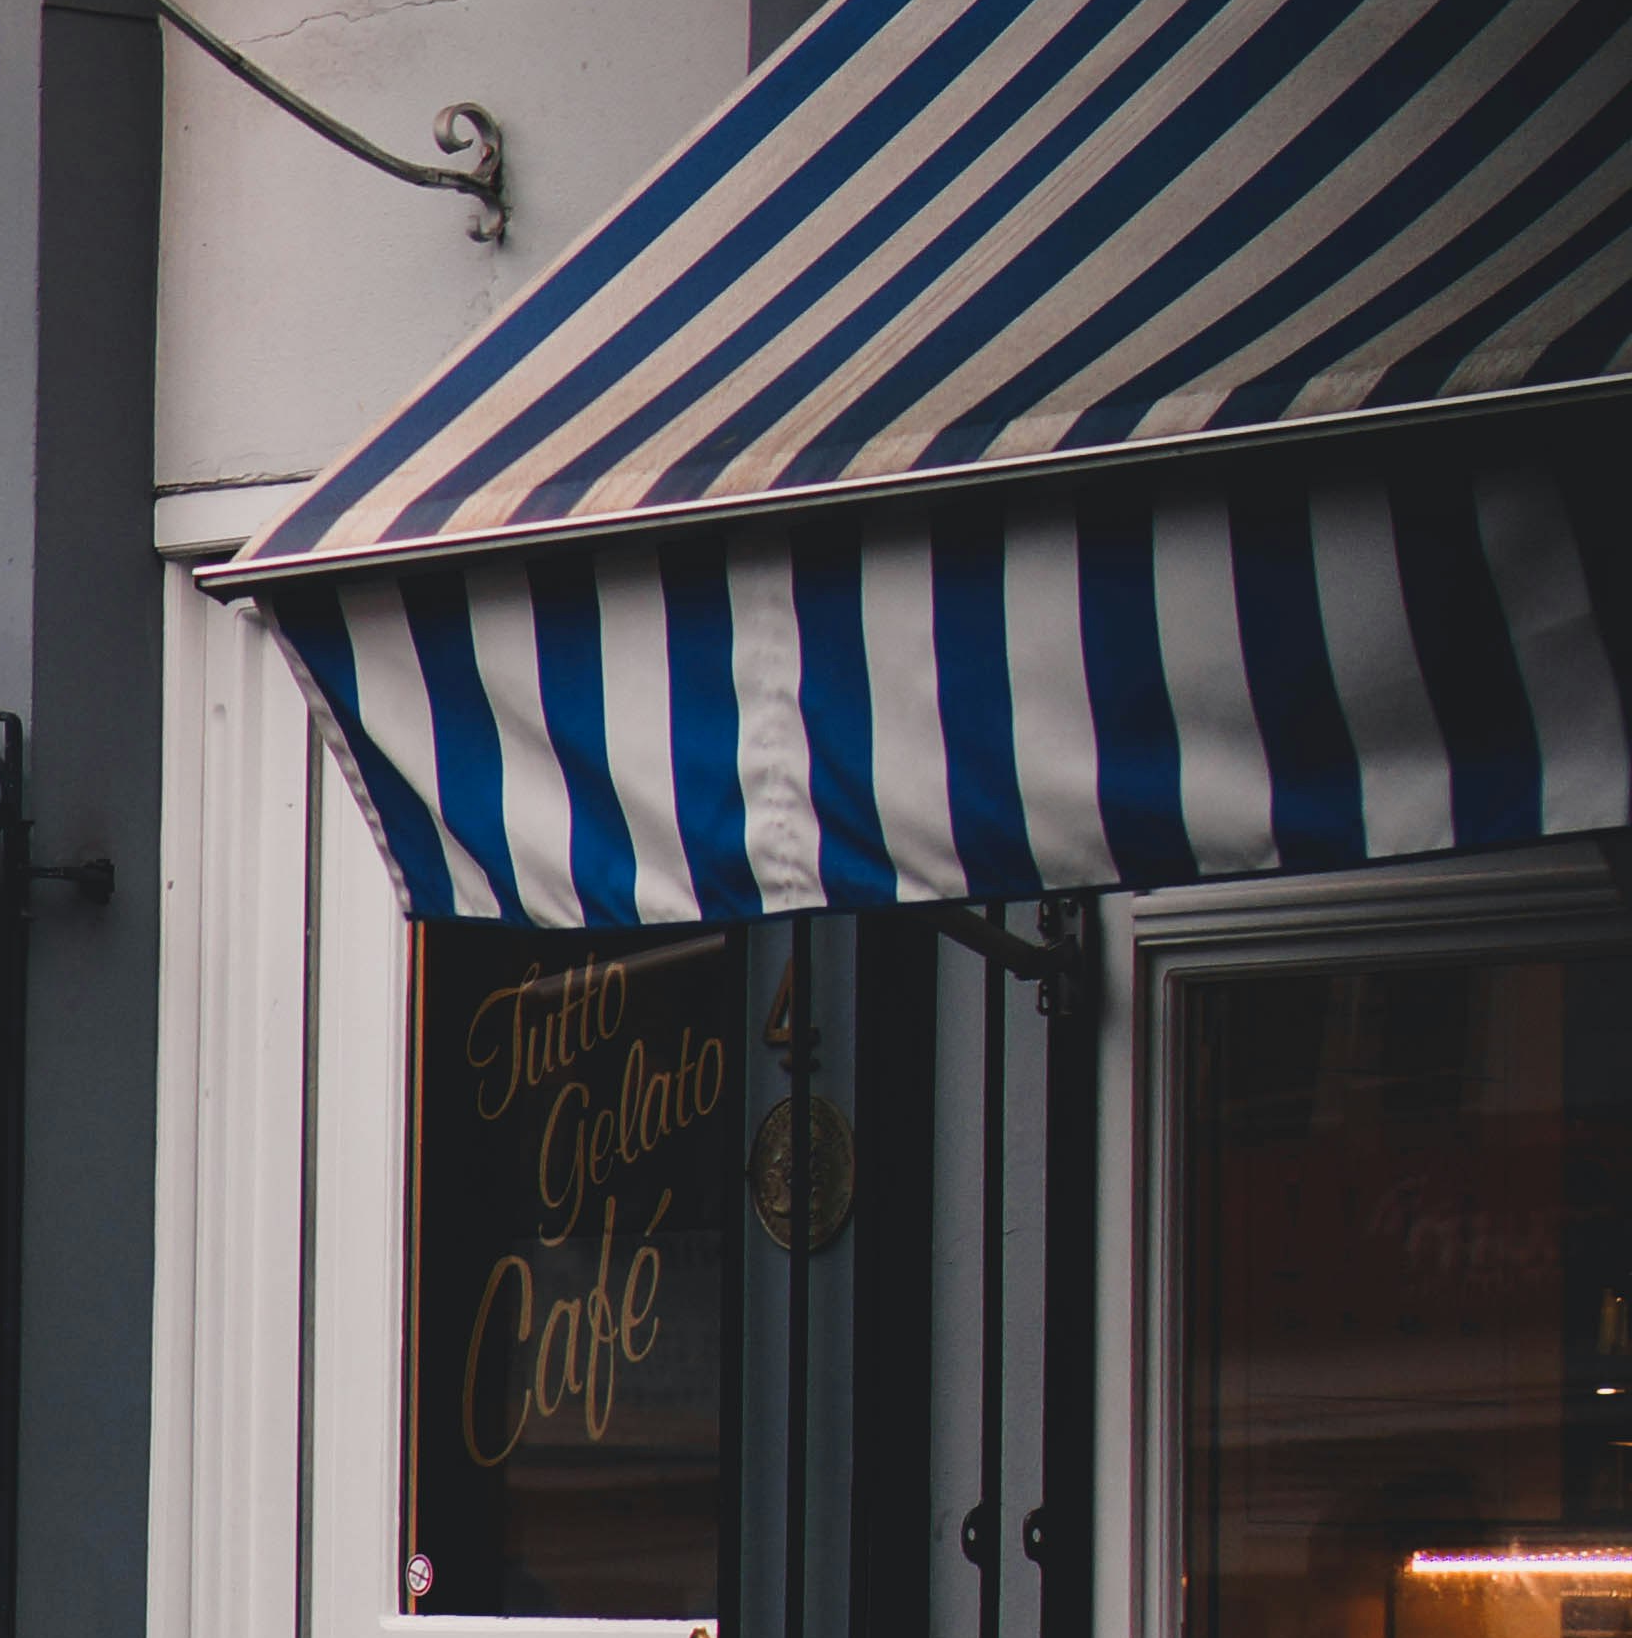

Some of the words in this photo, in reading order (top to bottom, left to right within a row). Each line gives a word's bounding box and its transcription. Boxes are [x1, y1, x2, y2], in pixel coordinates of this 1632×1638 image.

[468, 952, 626, 1120] Tutto
[538, 1026, 724, 1248] Gelato
[462, 1188, 671, 1467] Café
